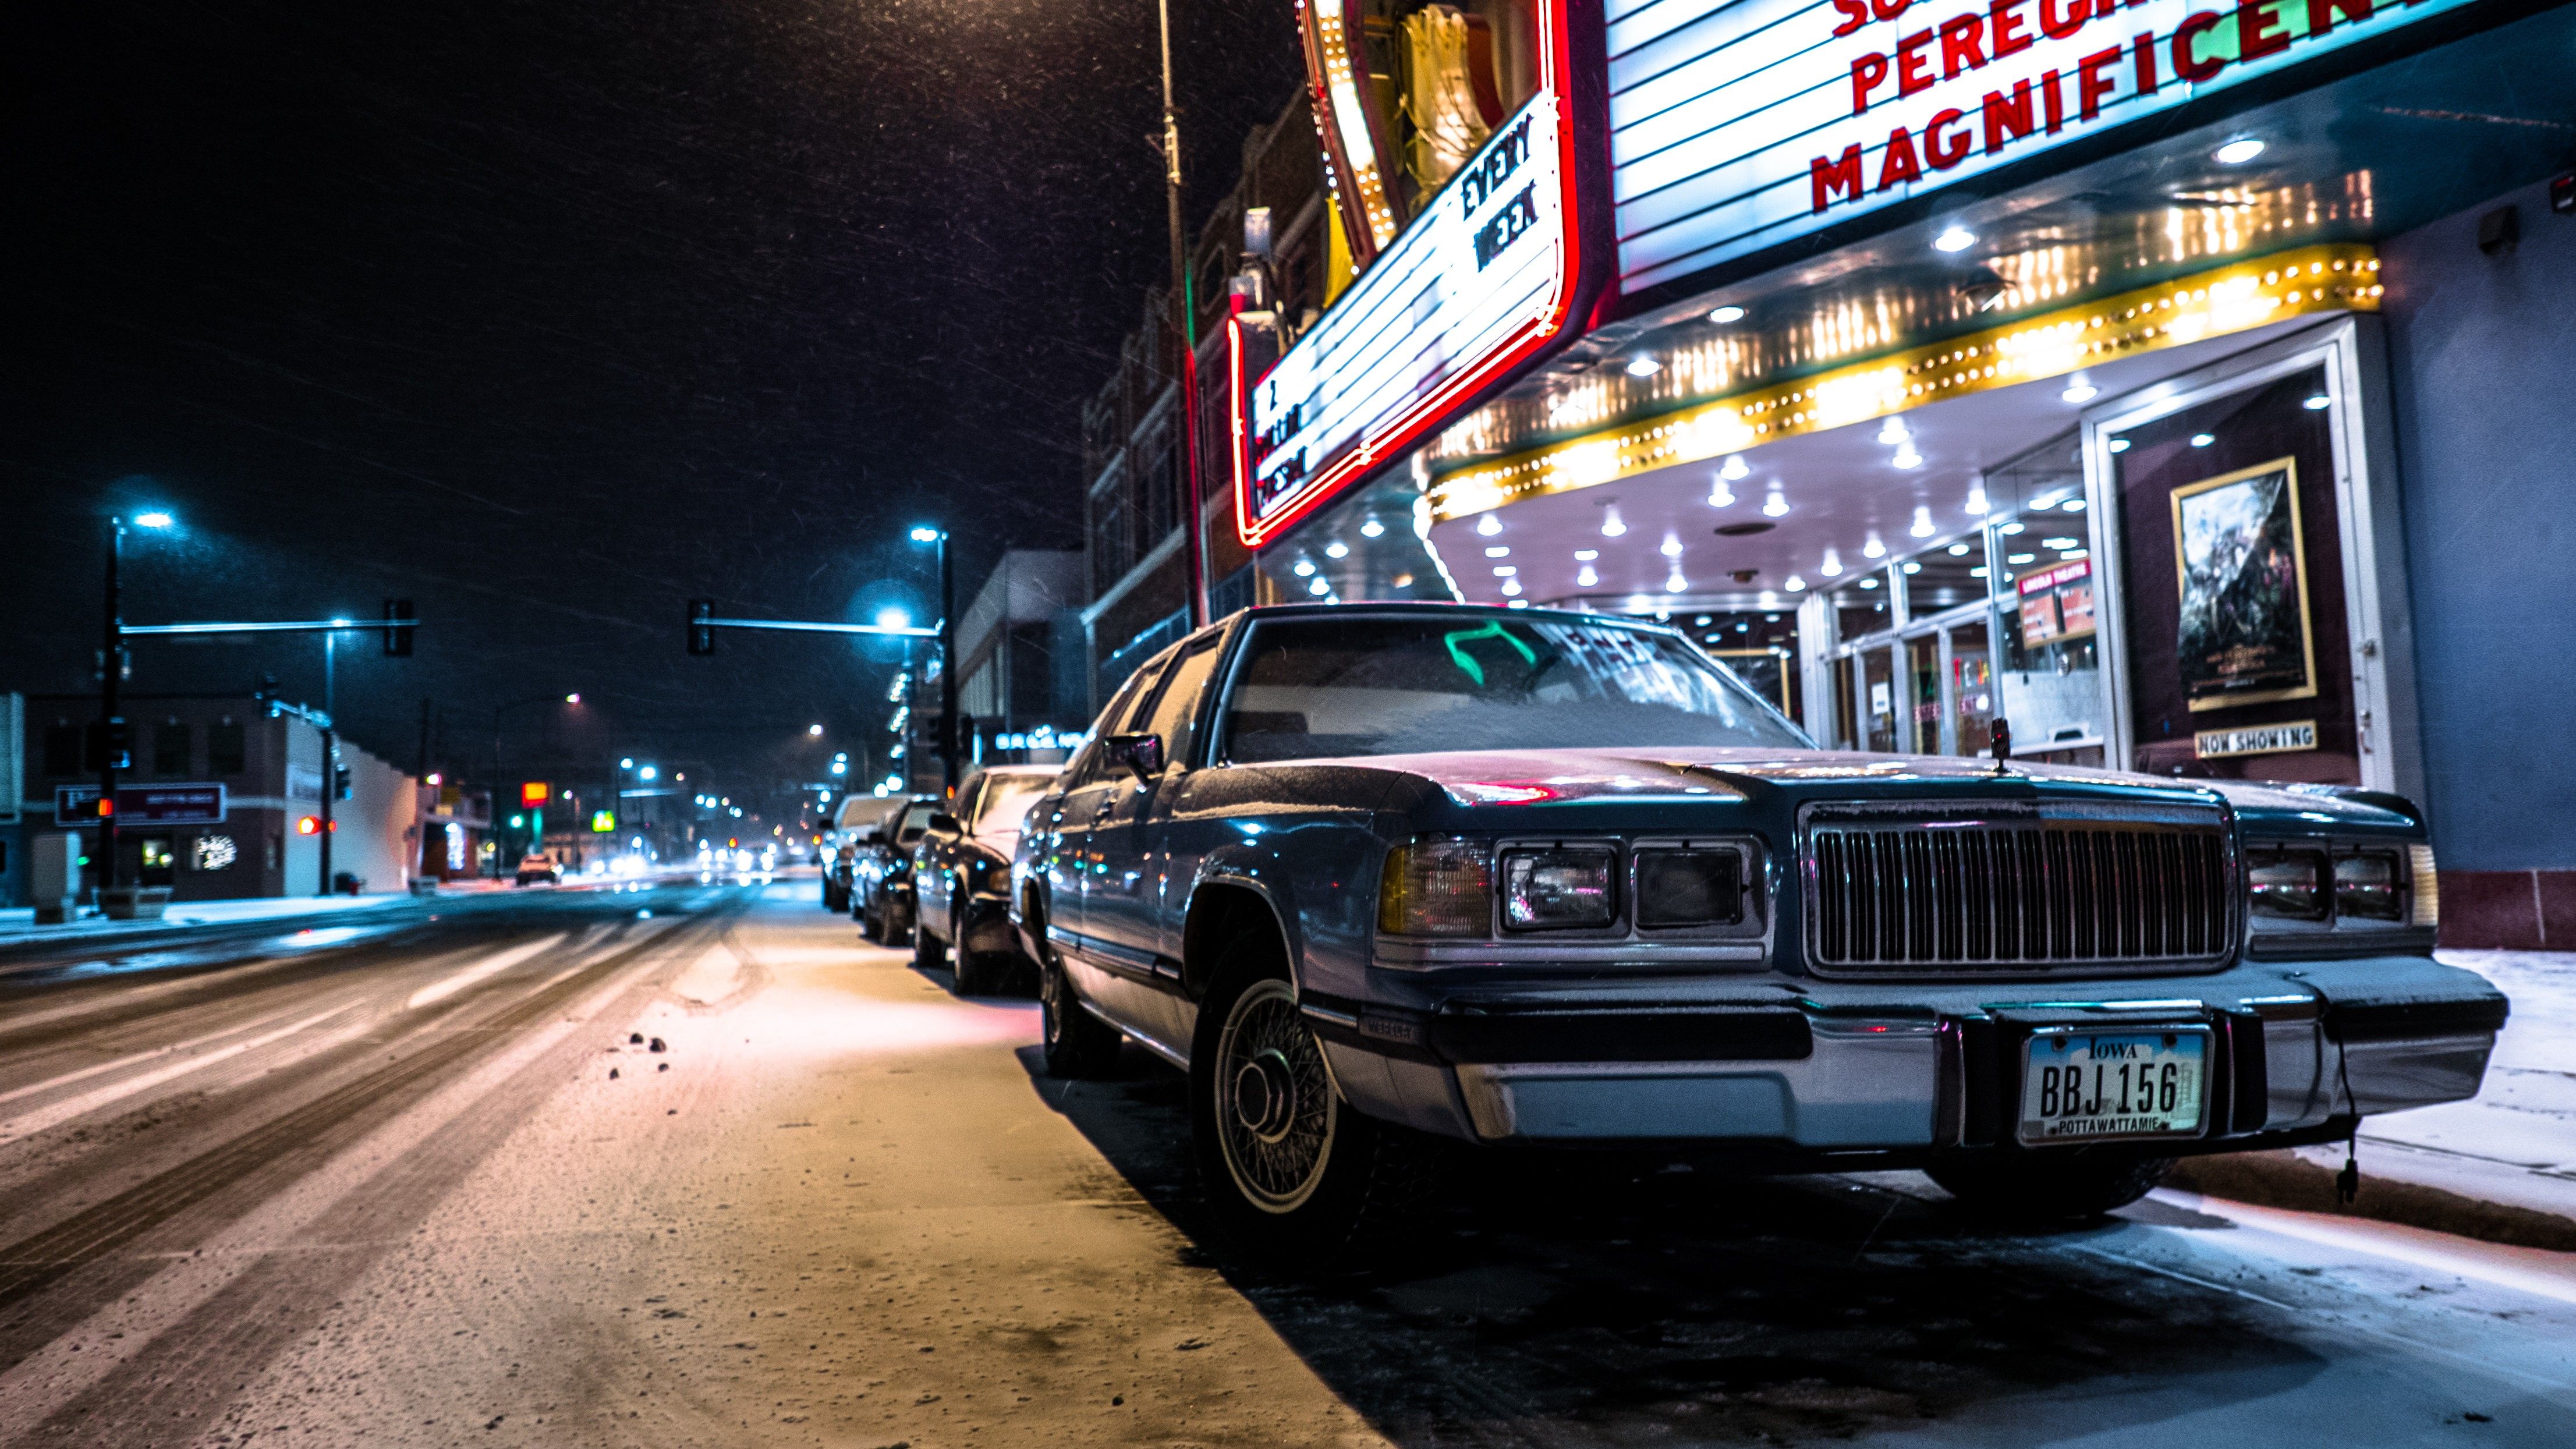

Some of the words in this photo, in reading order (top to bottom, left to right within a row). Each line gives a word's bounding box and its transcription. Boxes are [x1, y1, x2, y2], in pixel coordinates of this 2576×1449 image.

[1851, 0, 2149, 116] PEREG
[1461, 112, 1535, 222] EVERY
[2199, 734, 2230, 753] NOW
[2235, 726, 2313, 751] SHOWING
[2040, 1065, 2103, 1117] BBJ
[2116, 1062, 2178, 1114] 156
[2058, 1117, 2160, 1135] POTTAWATTAMIE
